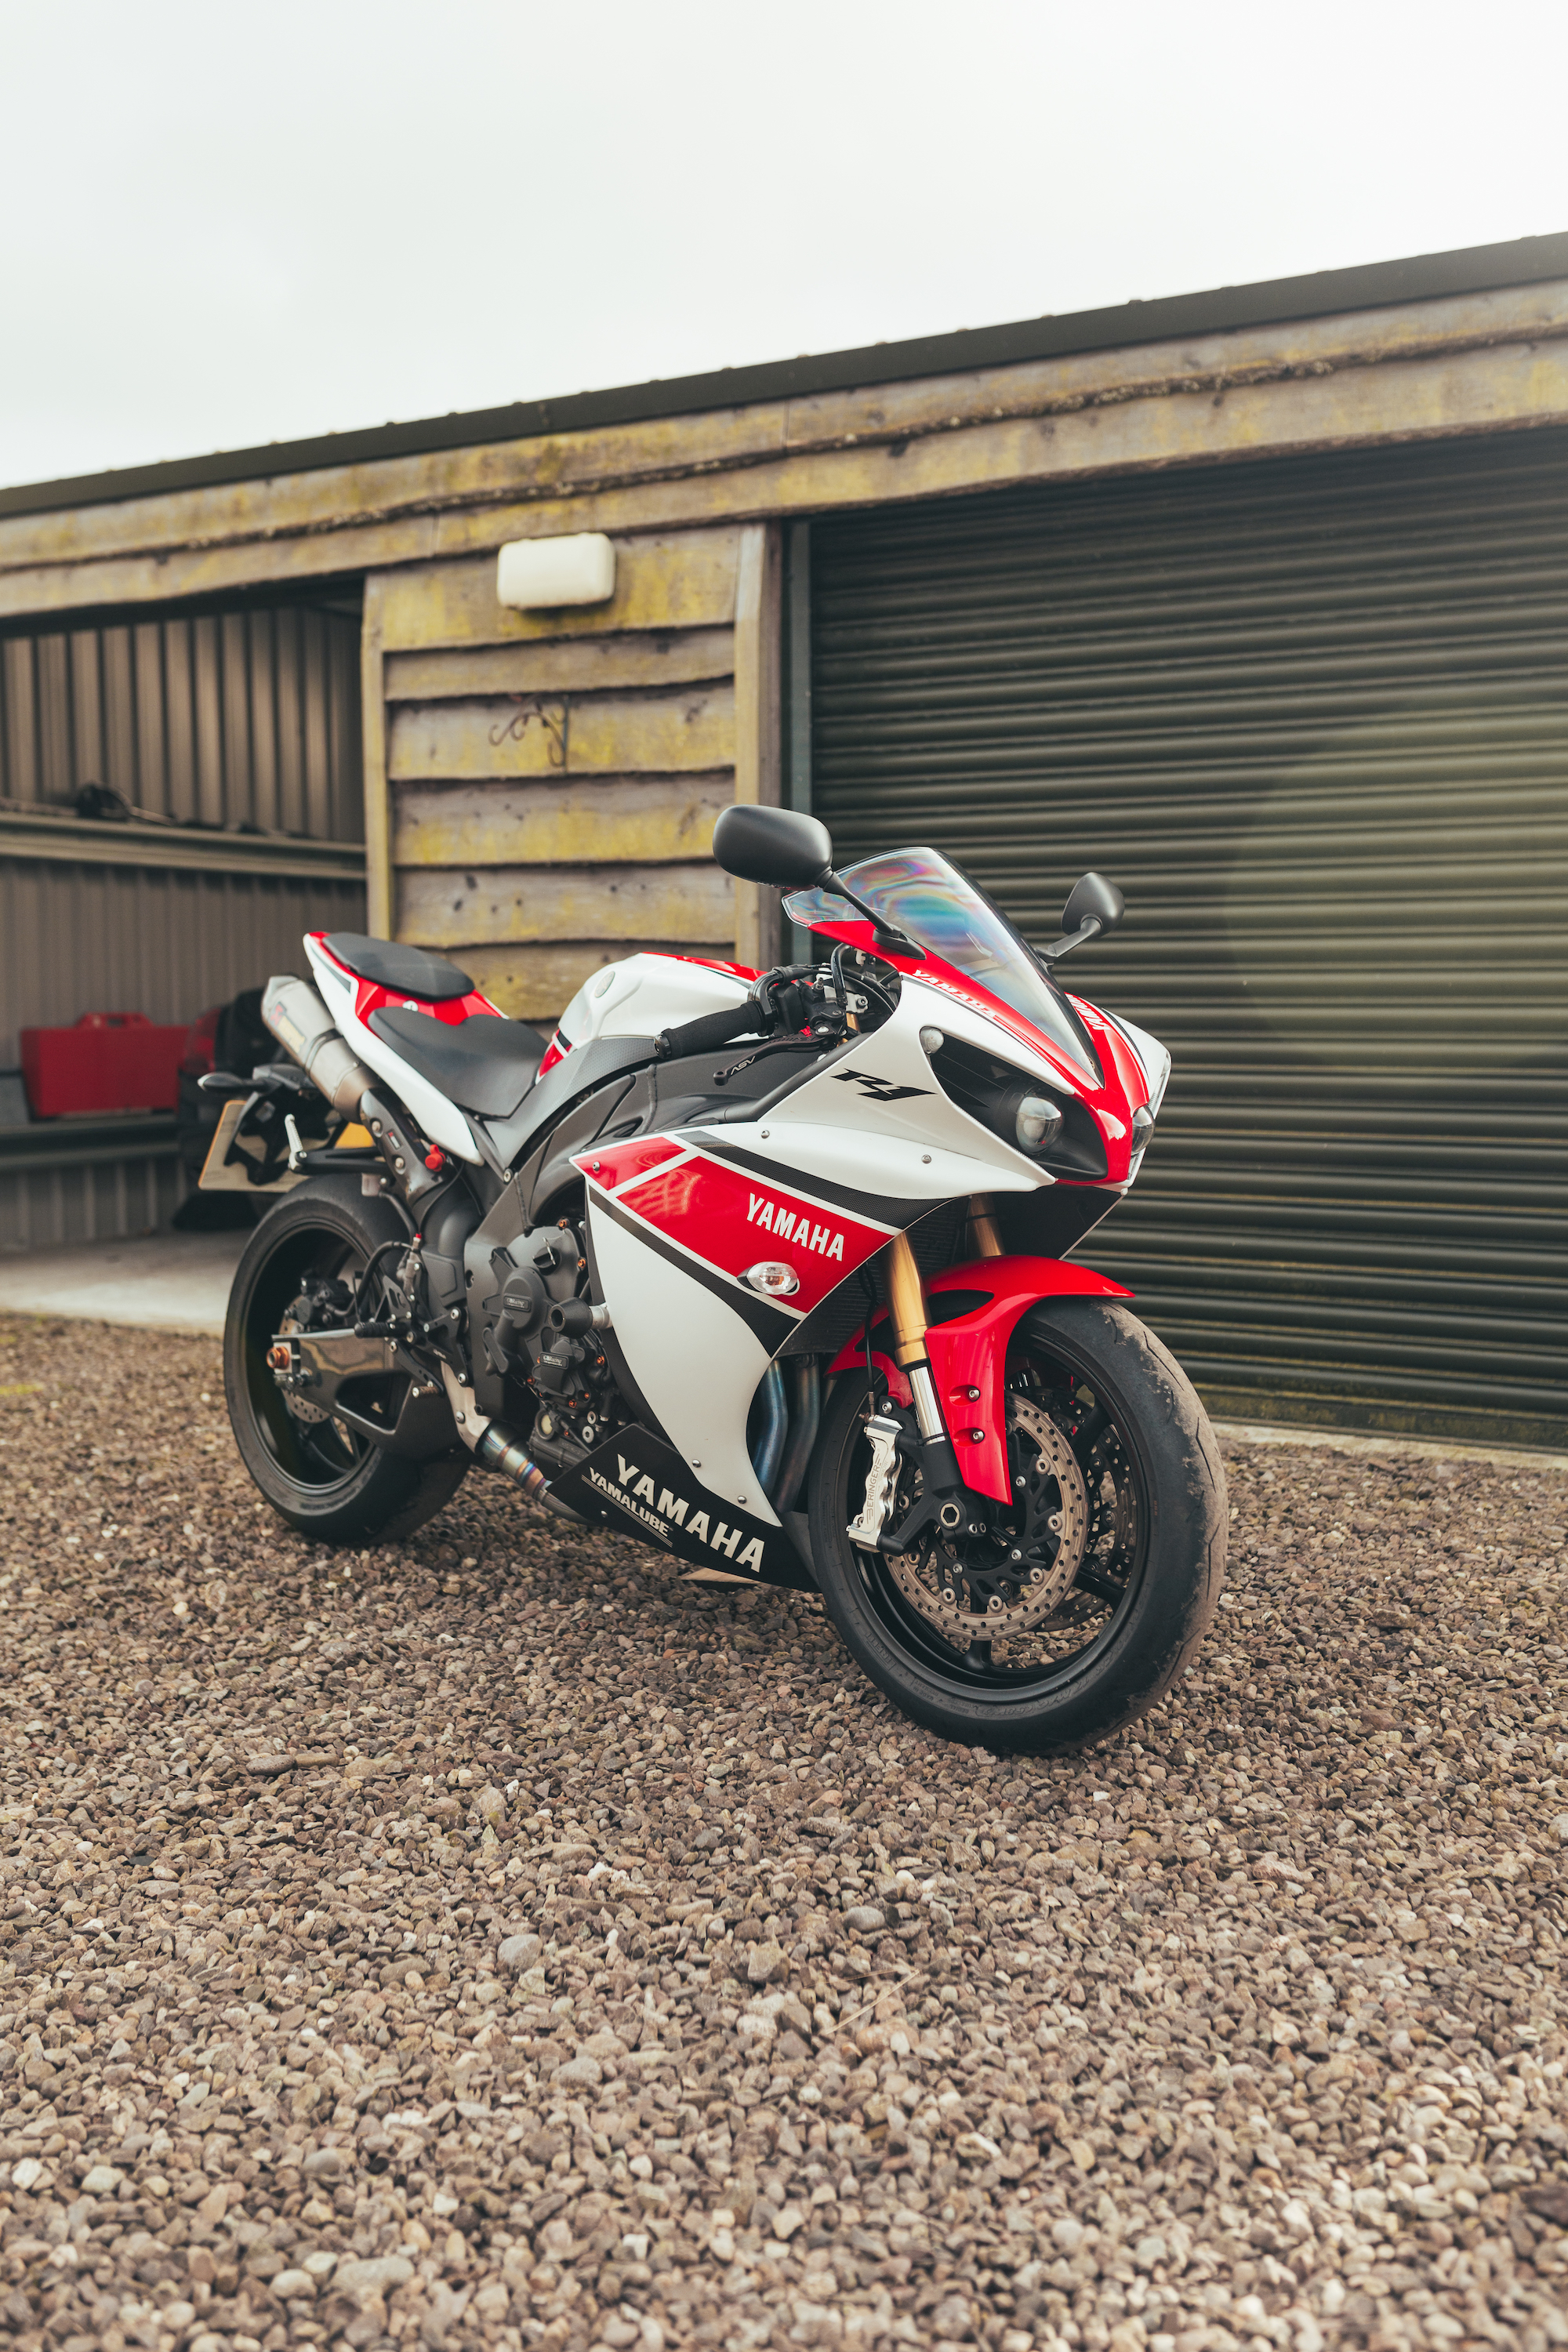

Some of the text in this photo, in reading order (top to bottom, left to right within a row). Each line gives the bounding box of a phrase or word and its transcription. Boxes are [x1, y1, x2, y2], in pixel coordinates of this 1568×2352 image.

[912, 969, 996, 1018] YAMAHA
[730, 1055, 756, 1076] ASV
[746, 1192, 844, 1262] YAMAHA
[589, 1466, 670, 1537] YAMALUBE
[617, 1454, 765, 1573] YAMAHA
[867, 1453, 882, 1524] BERINGER
